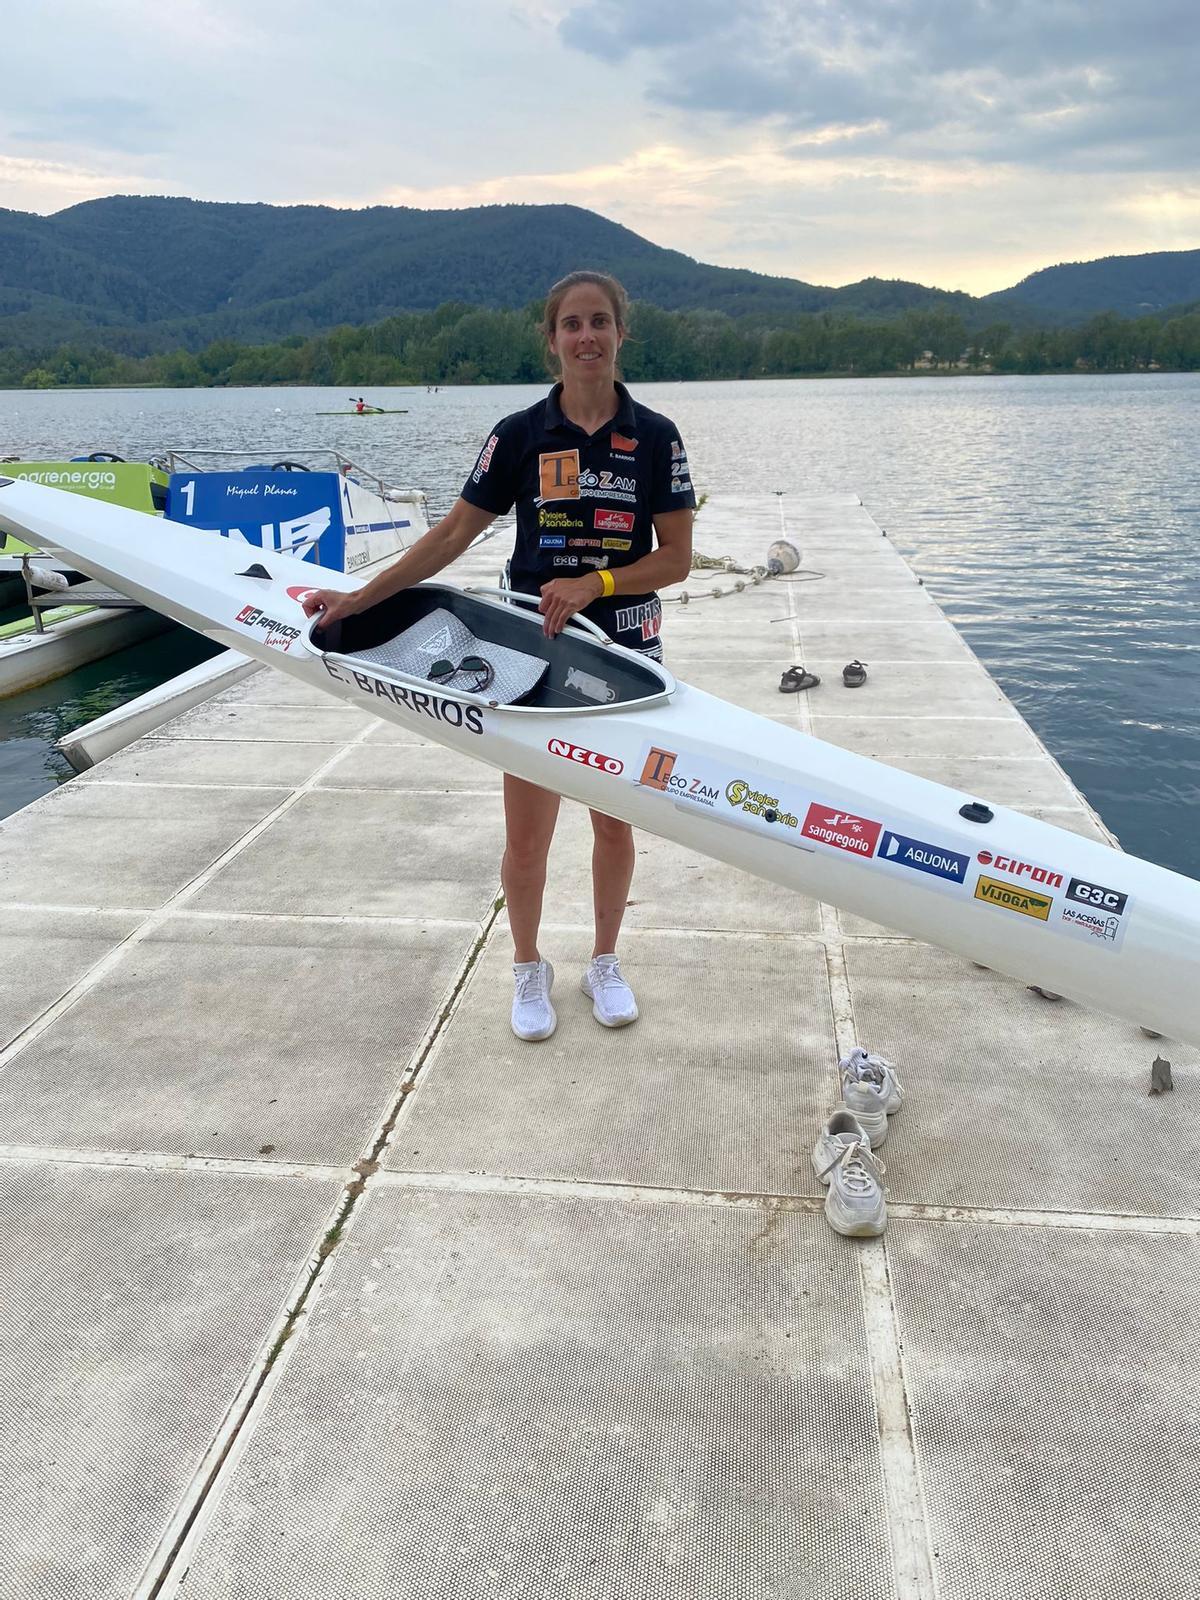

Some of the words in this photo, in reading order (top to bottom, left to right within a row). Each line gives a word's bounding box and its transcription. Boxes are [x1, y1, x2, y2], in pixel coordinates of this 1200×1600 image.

[181, 481, 195, 516] 1
[226, 484, 259, 499] Miguel
[264, 484, 298, 496] Planas
[343, 482, 354, 519] 1
[546, 519, 583, 527] sanabria
[553, 556, 578, 566] G3C
[256, 617, 301, 639] RAMOS
[264, 631, 293, 651] Tuning
[322, 658, 351, 683] E.
[354, 671, 484, 735] BARRIOS
[550, 740, 622, 774] NELO
[679, 790, 715, 807] EMPRESARIAL
[748, 788, 779, 808] viajes
[743, 800, 798, 828] sanbria
[807, 823, 869, 852] sangregorio
[904, 847, 960, 875] AQUONA
[980, 884, 1031, 910] VIJOGA
[1075, 884, 1119, 907] G3C
[1063, 908, 1077, 918] LAS
